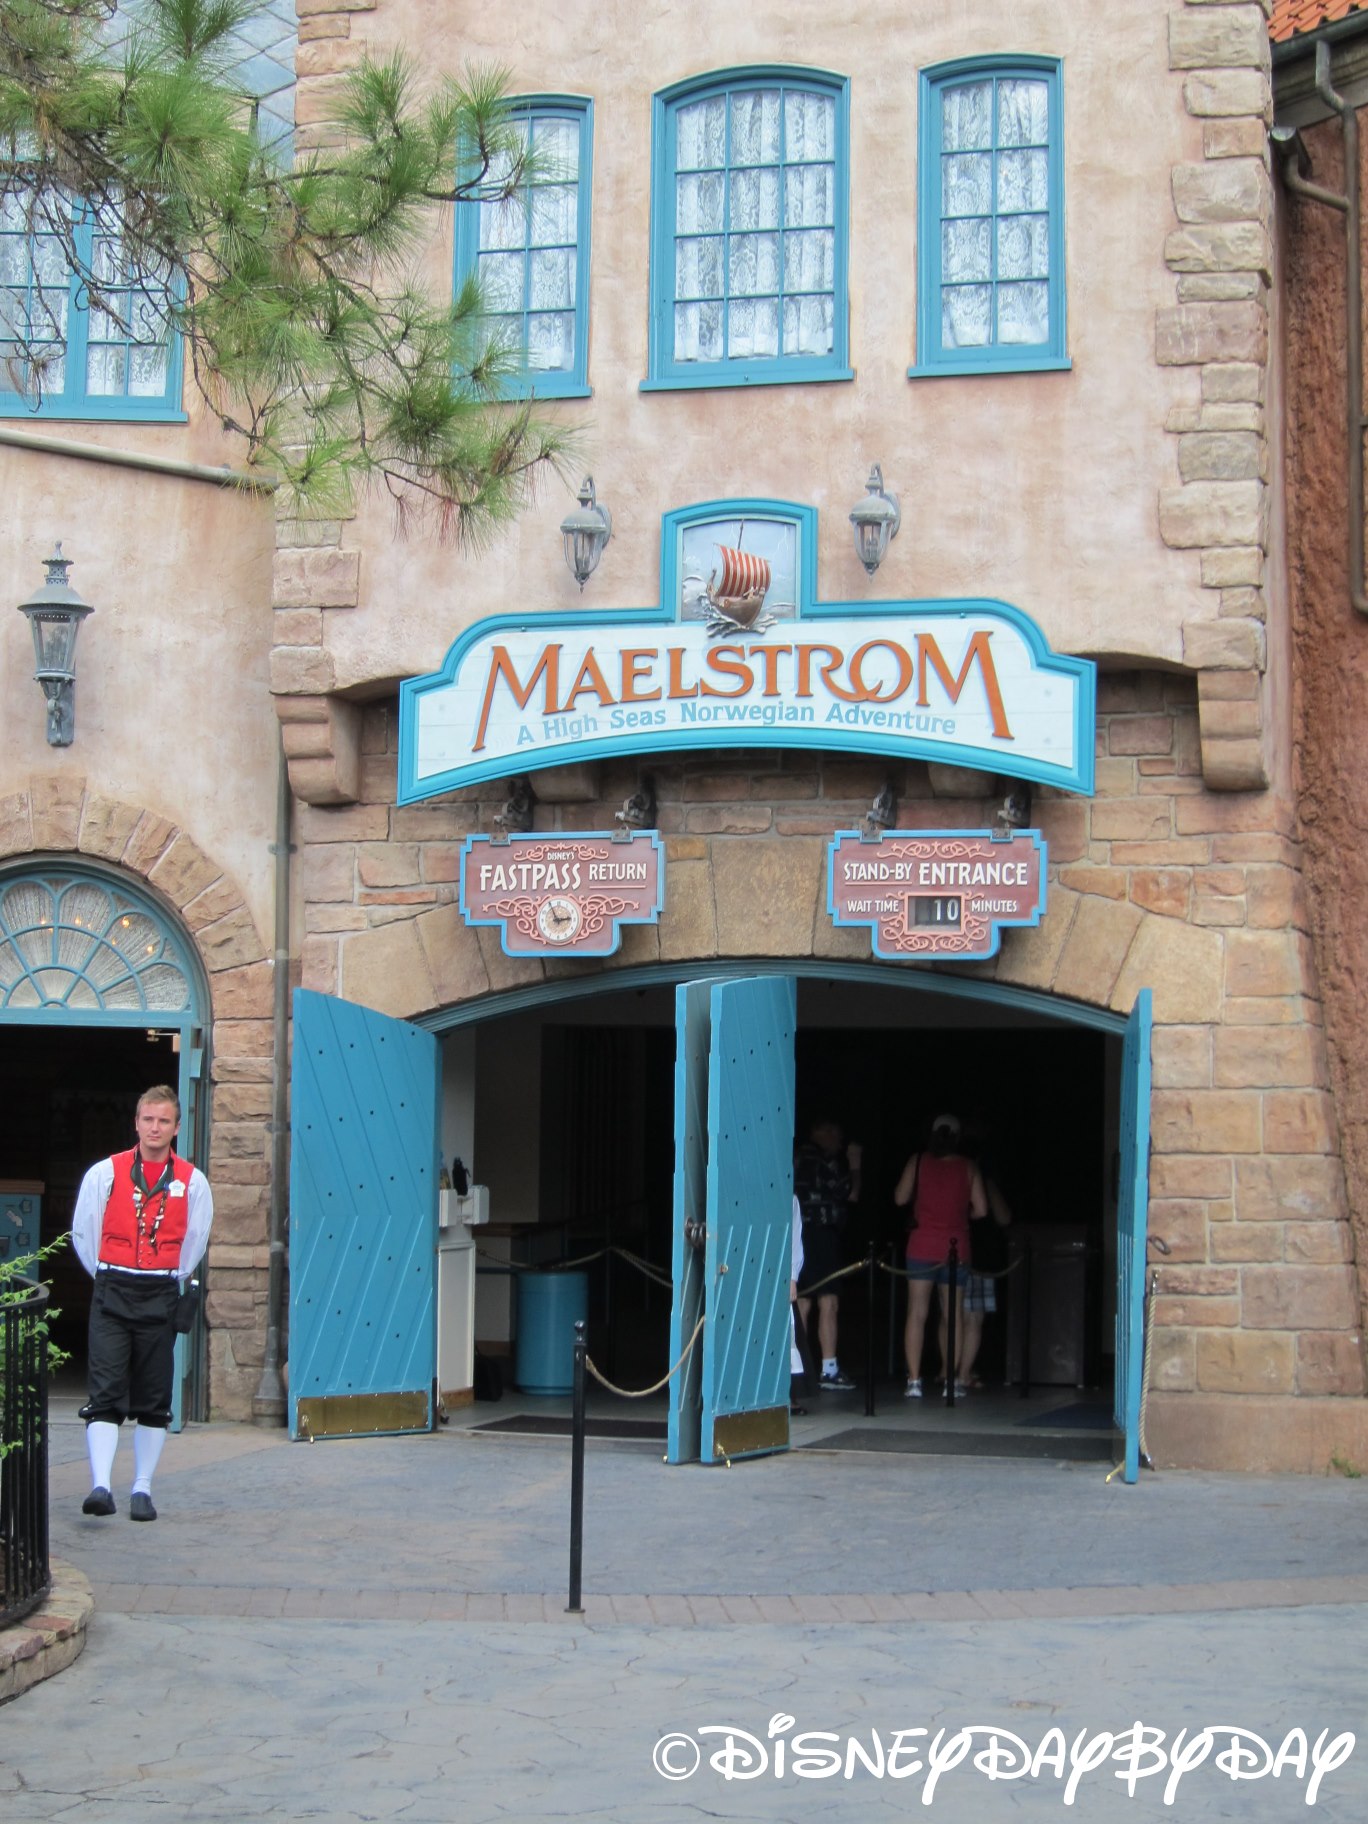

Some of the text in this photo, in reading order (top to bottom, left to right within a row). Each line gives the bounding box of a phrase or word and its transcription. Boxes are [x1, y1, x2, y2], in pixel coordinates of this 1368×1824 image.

[472, 630, 1015, 753] MAELSTROM
[516, 701, 957, 746] A High Seas Norwegian Adventure
[546, 851, 576, 861] DISNEY'S
[479, 862, 647, 892] FASTPASS RETURN
[843, 861, 1029, 886] STAND-BY ENTRANCE
[847, 898, 1018, 921] WAIT TIME 10 MINUTES
